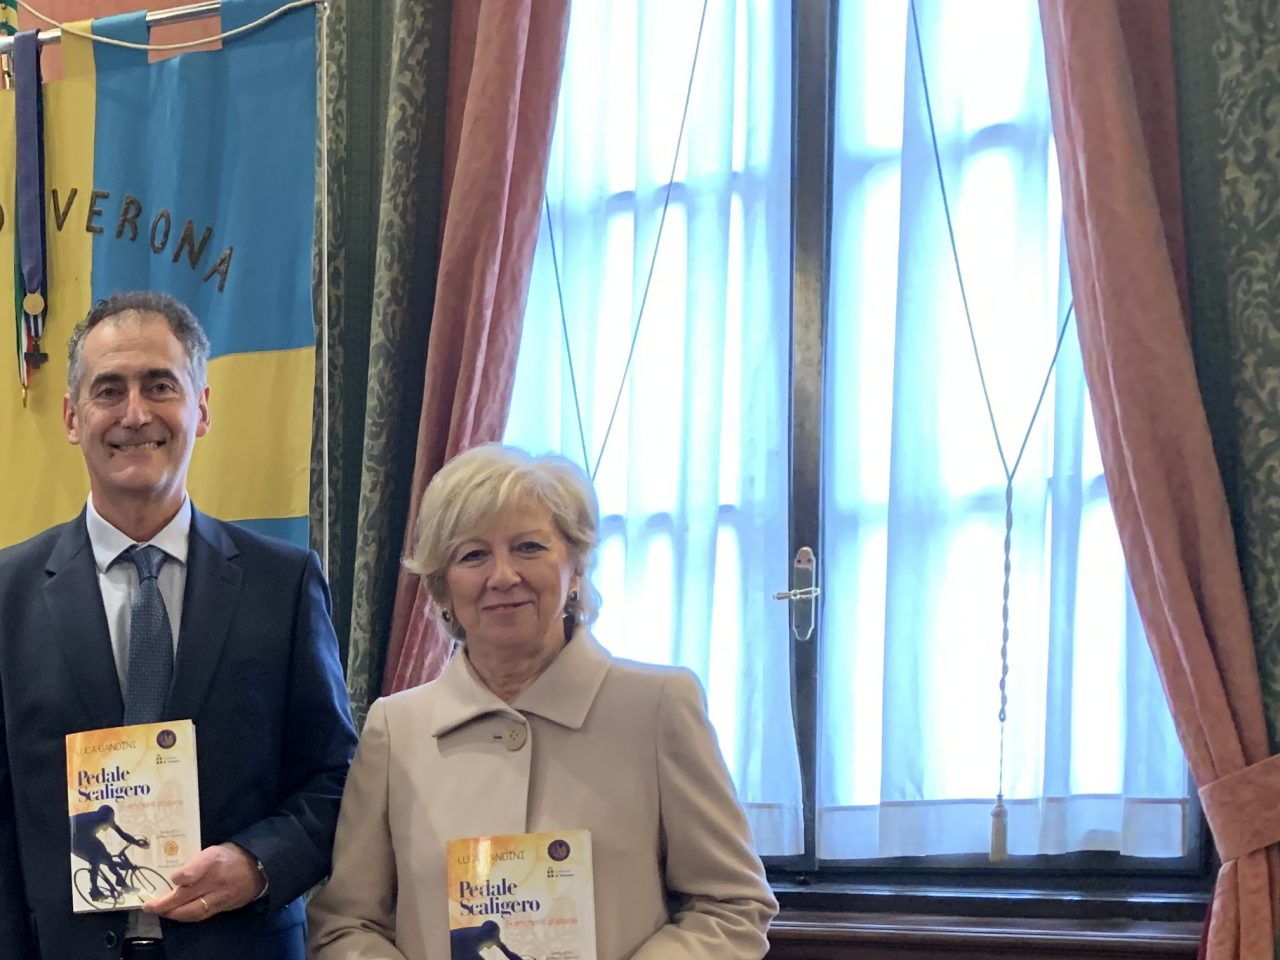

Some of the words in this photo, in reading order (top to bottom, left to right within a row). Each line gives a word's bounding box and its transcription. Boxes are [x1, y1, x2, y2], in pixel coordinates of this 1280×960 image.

[51, 187, 235, 293] VERONA
[78, 766, 130, 786] Pedale
[78, 783, 151, 803] Scaligero
[459, 878, 518, 898] Pedale
[460, 897, 541, 919] Scaligero
